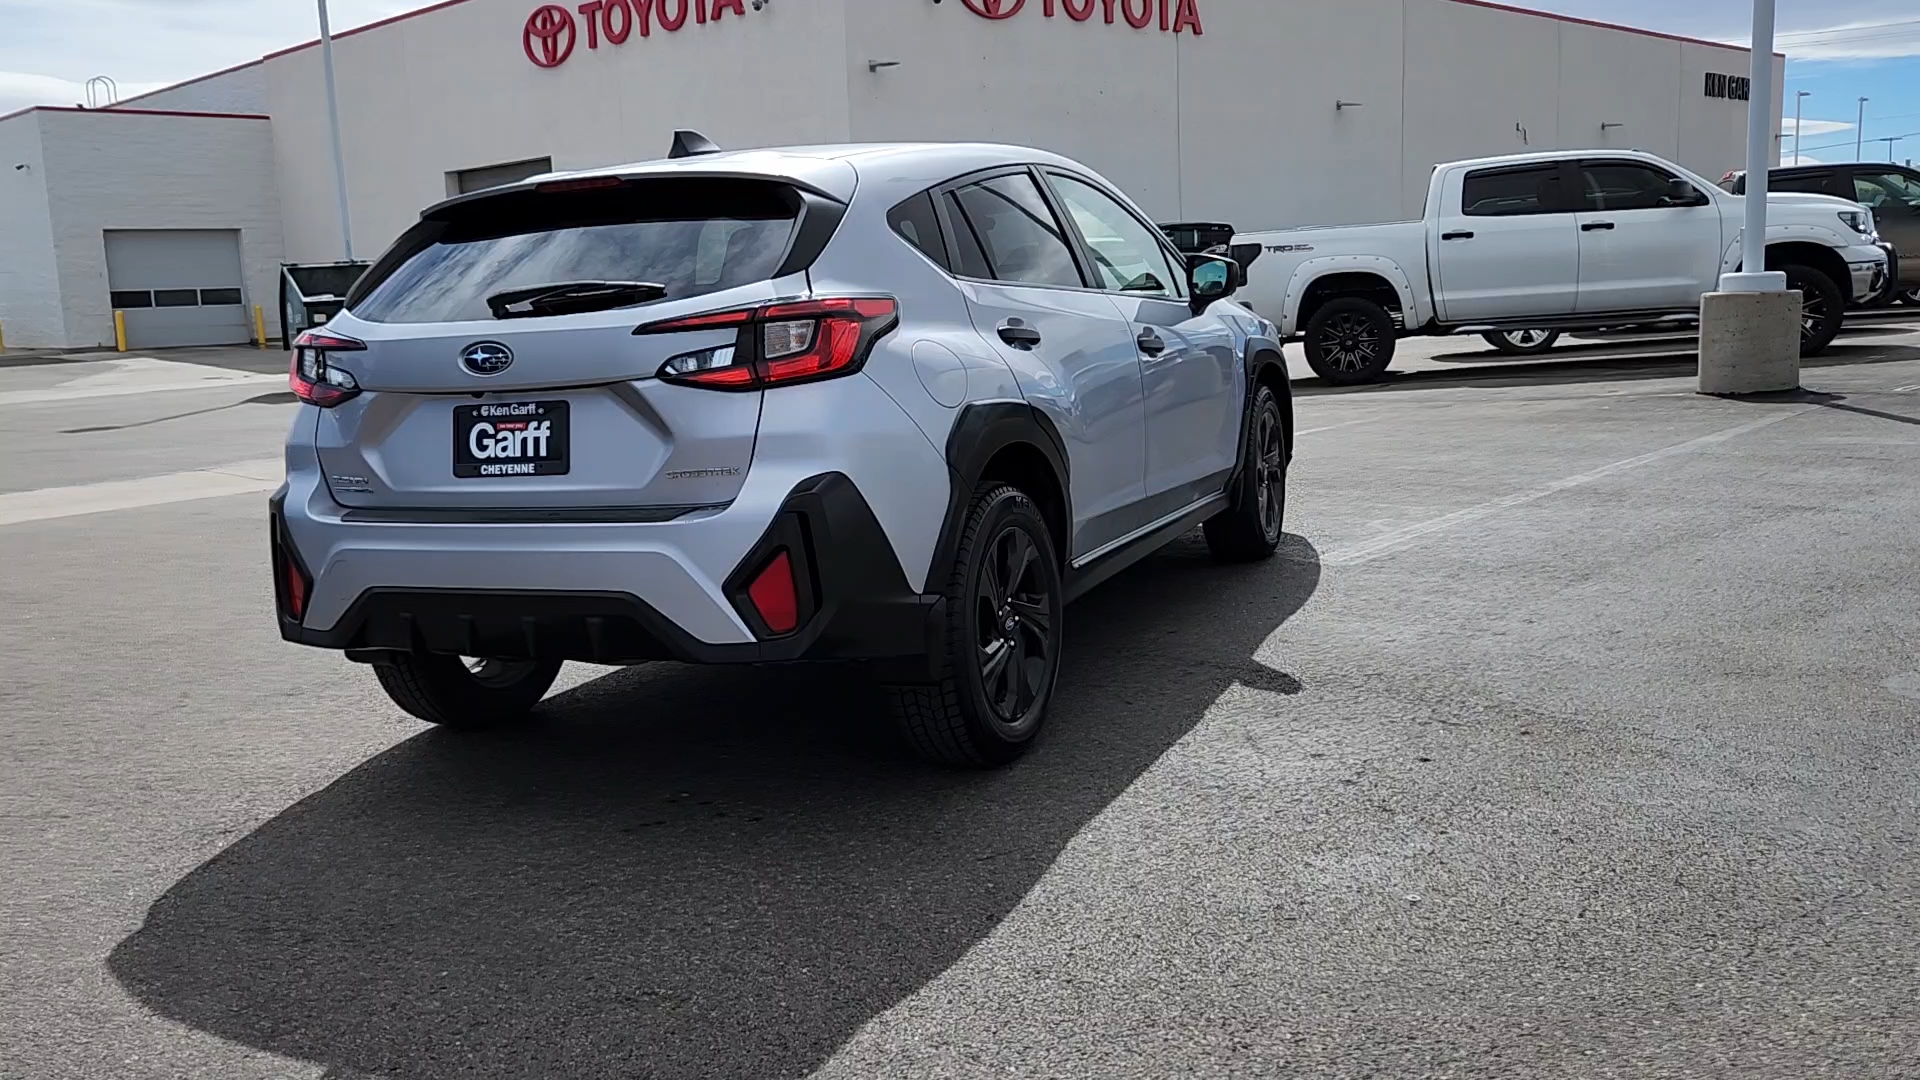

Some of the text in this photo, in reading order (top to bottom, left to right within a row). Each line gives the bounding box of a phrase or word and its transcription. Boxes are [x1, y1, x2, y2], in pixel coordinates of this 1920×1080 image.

[578, 0, 745, 49] TOYO
[1264, 245, 1293, 254] TRD
[489, 403, 537, 416] Ken Garff
[469, 420, 551, 459] Garff
[481, 463, 535, 475] CHEYENNE
